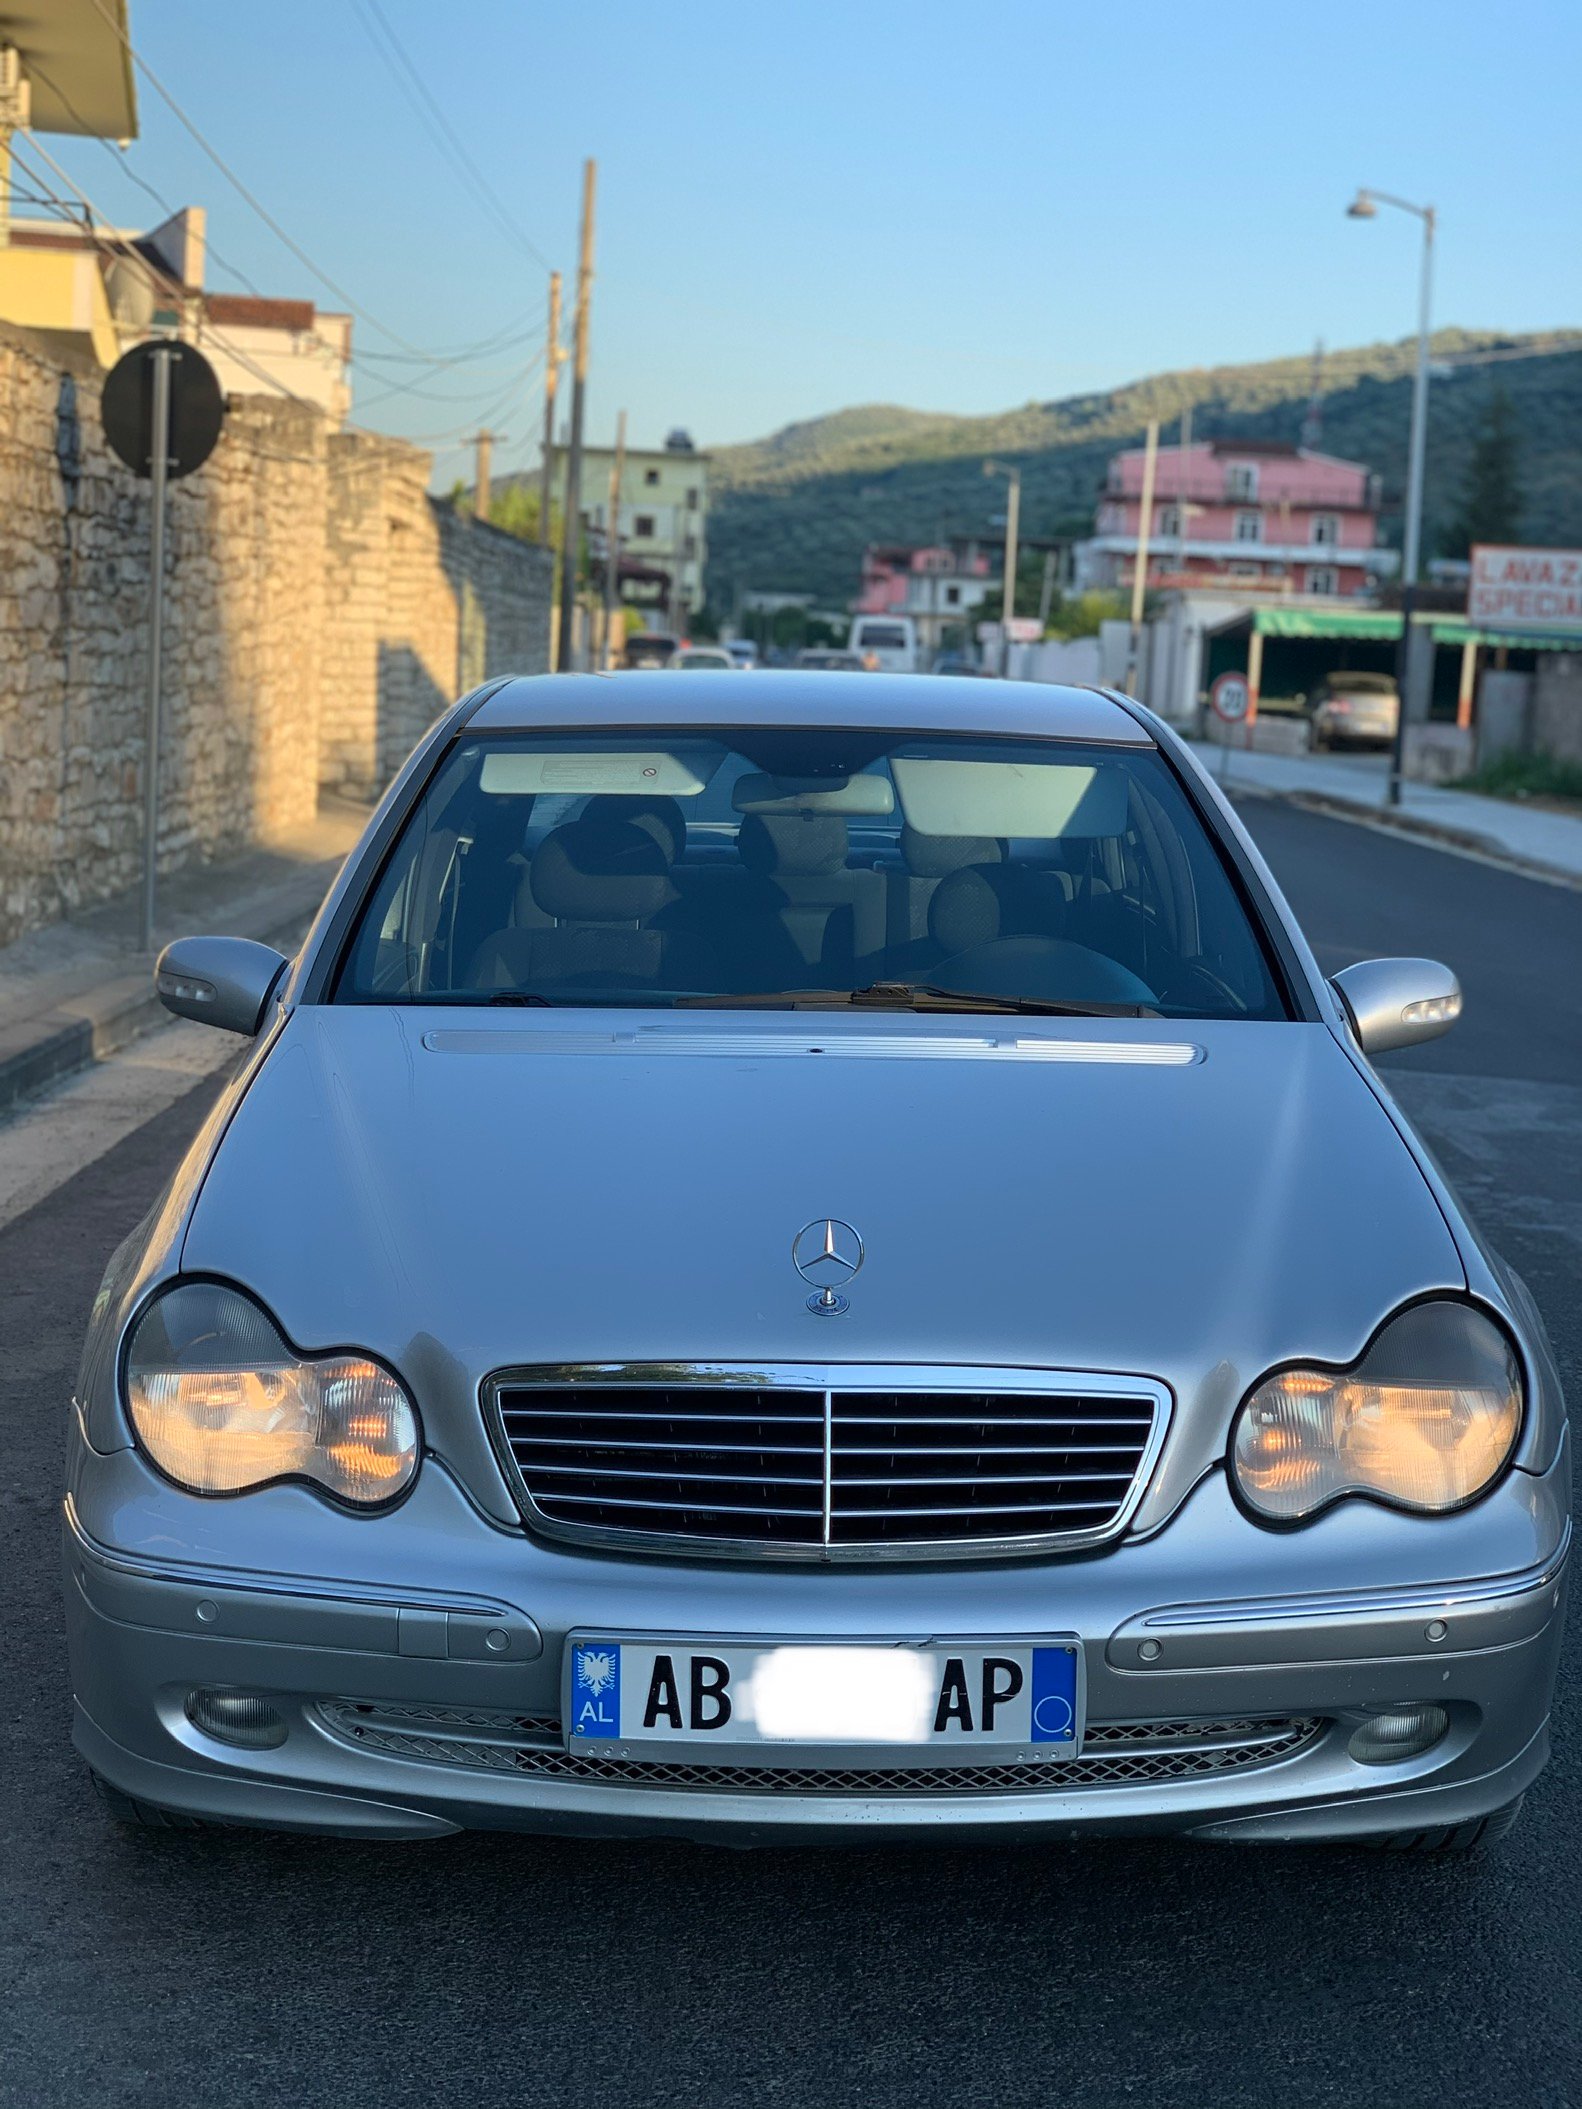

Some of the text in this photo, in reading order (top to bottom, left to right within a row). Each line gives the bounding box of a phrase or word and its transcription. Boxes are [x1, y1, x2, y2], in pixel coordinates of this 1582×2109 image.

[579, 1701, 613, 1722] AL
[643, 1655, 1023, 1731] AB AP
